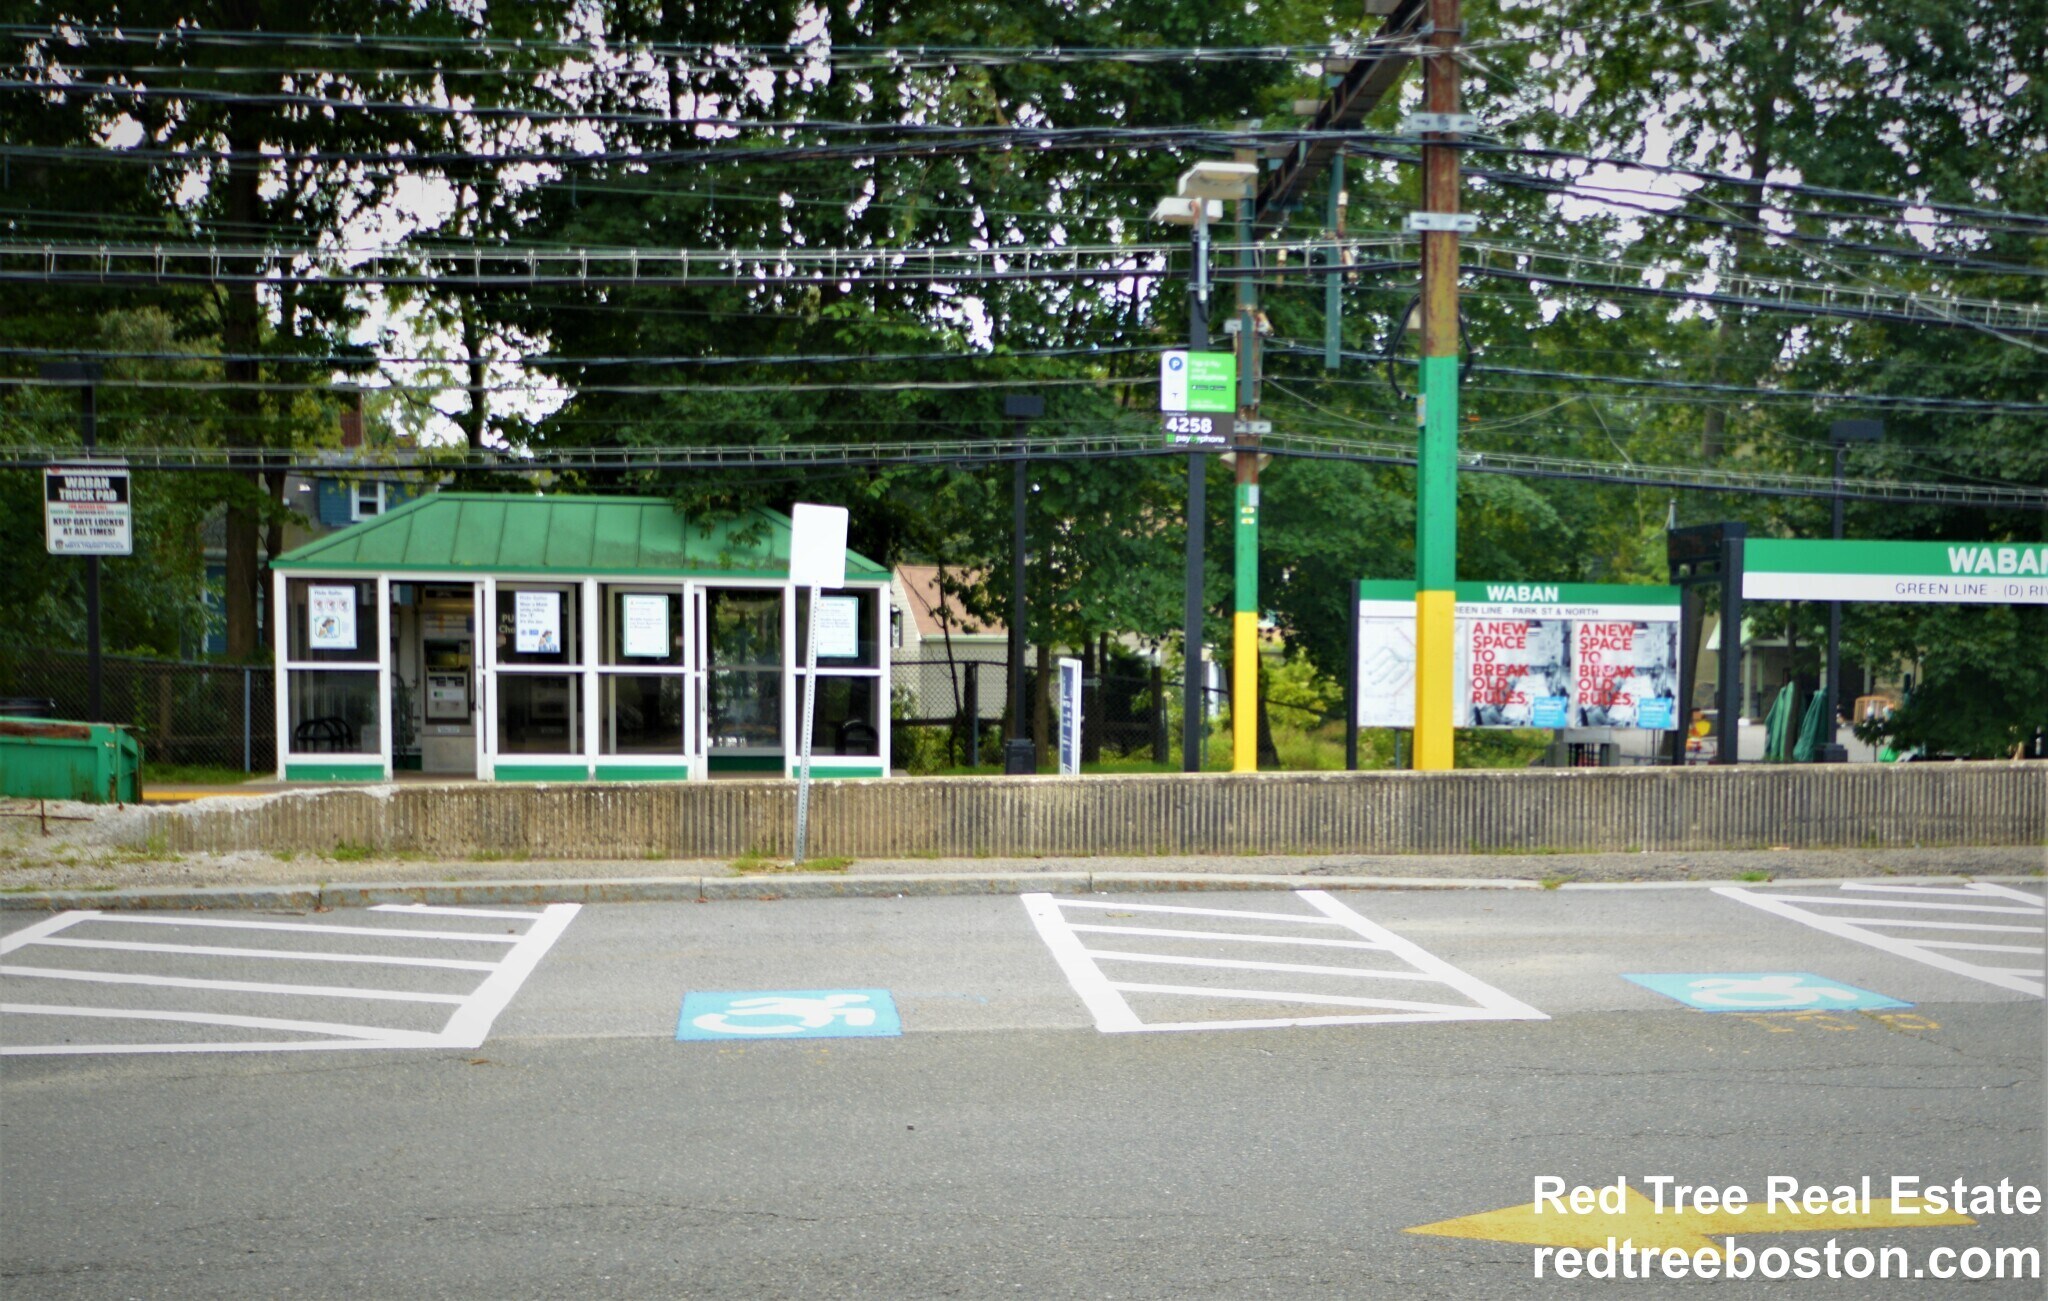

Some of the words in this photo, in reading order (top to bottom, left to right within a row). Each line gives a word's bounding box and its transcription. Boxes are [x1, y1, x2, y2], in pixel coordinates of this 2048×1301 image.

[1166, 417, 1212, 433] 4258
[65, 476, 110, 488] WABAN
[59, 488, 95, 501] TRUCK
[96, 489, 117, 502] PAD
[73, 518, 94, 526] GATE
[94, 518, 124, 526] LOCKED
[1486, 585, 1559, 602] WABAN
[1895, 583, 1949, 595] GREEN
[1954, 584, 1988, 596] LINE
[2003, 584, 2024, 598] (D)
[1454, 606, 1478, 615] REEN
[1481, 607, 1503, 615] LINE
[1512, 607, 1538, 615] PARK
[1541, 608, 1553, 616] ST
[1556, 608, 1562, 616] &
[1565, 608, 1599, 616] NORTH
[1473, 622, 1484, 634] A
[1488, 622, 1529, 635] NEW
[1580, 623, 1591, 635] A
[1595, 623, 1635, 636] NEW
[1473, 636, 1526, 649] SPACE
[1580, 637, 1632, 650] SPACE
[1473, 650, 1495, 662] TO
[1579, 651, 1601, 663] TO
[1473, 664, 1528, 676] BREAK
[1472, 677, 1507, 690] OLD
[1578, 678, 1614, 691] OLD
